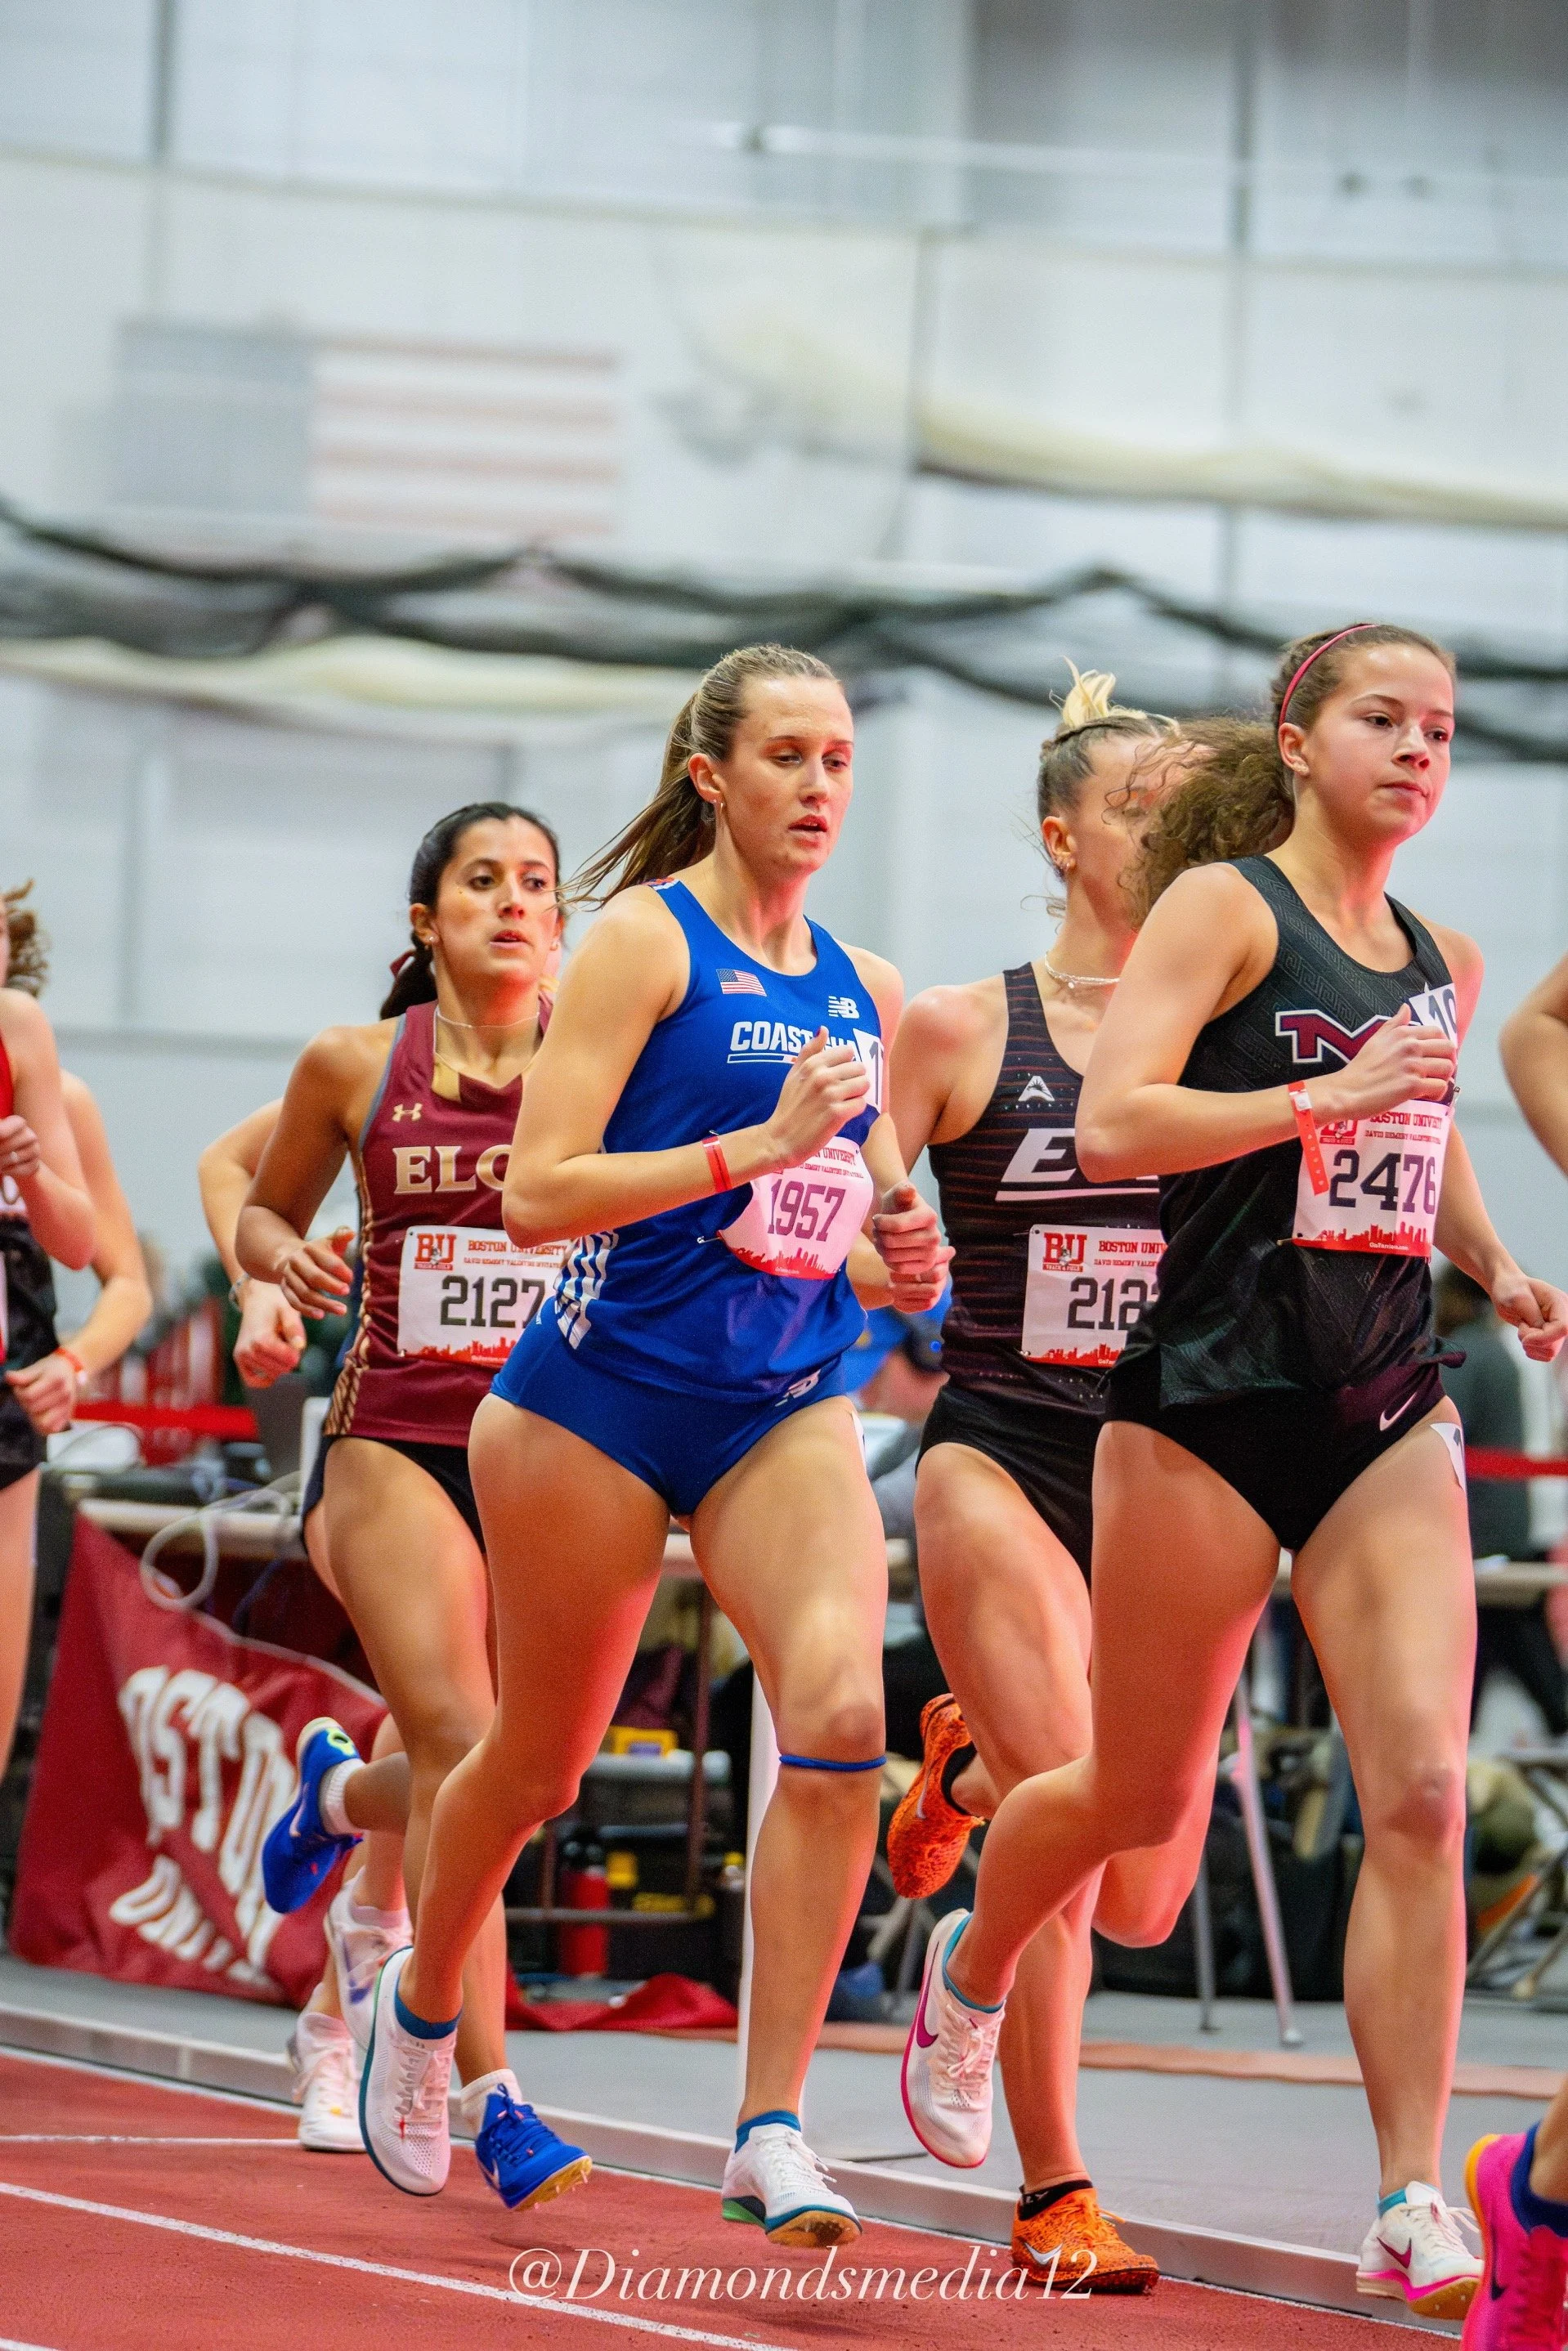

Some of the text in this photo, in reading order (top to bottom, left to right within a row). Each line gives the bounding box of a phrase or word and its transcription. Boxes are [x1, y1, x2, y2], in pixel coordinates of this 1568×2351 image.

[730, 1020, 814, 1053] COAST
[392, 1144, 513, 1194] ELO
[1328, 1149, 1436, 1215] 2476
[768, 1179, 846, 1242] 1957
[414, 1234, 456, 1263] BU
[468, 1239, 507, 1252] BOSTON
[1042, 1232, 1087, 1265] BU
[1098, 1240, 1138, 1253] BOSTON
[440, 1274, 545, 1329] 2127
[1067, 1277, 1159, 1331] 212
